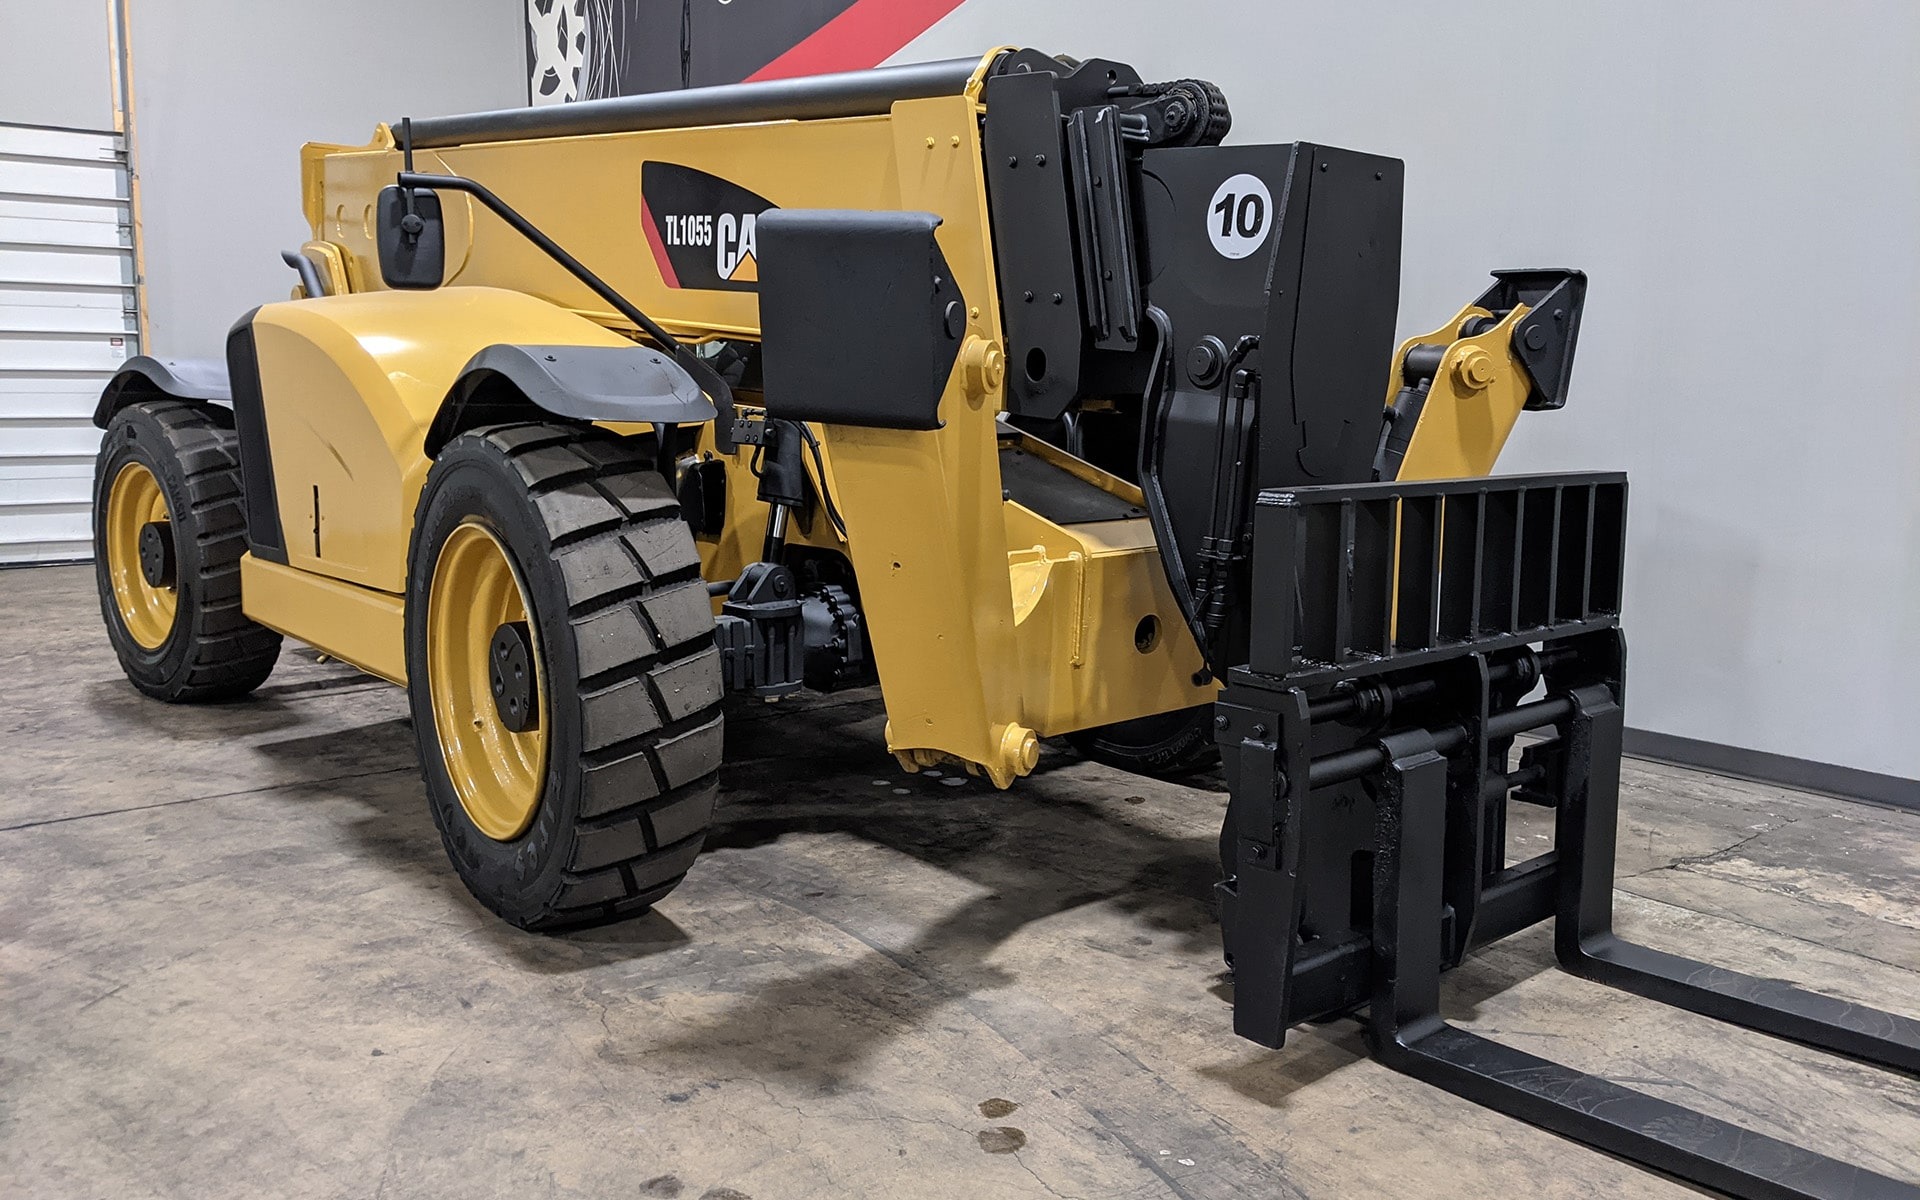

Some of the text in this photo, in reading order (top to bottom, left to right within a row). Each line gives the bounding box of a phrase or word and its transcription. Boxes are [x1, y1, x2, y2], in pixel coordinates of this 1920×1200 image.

[666, 215, 712, 246] TL1055
[1215, 193, 1264, 238] 10
[717, 213, 757, 280] CA
